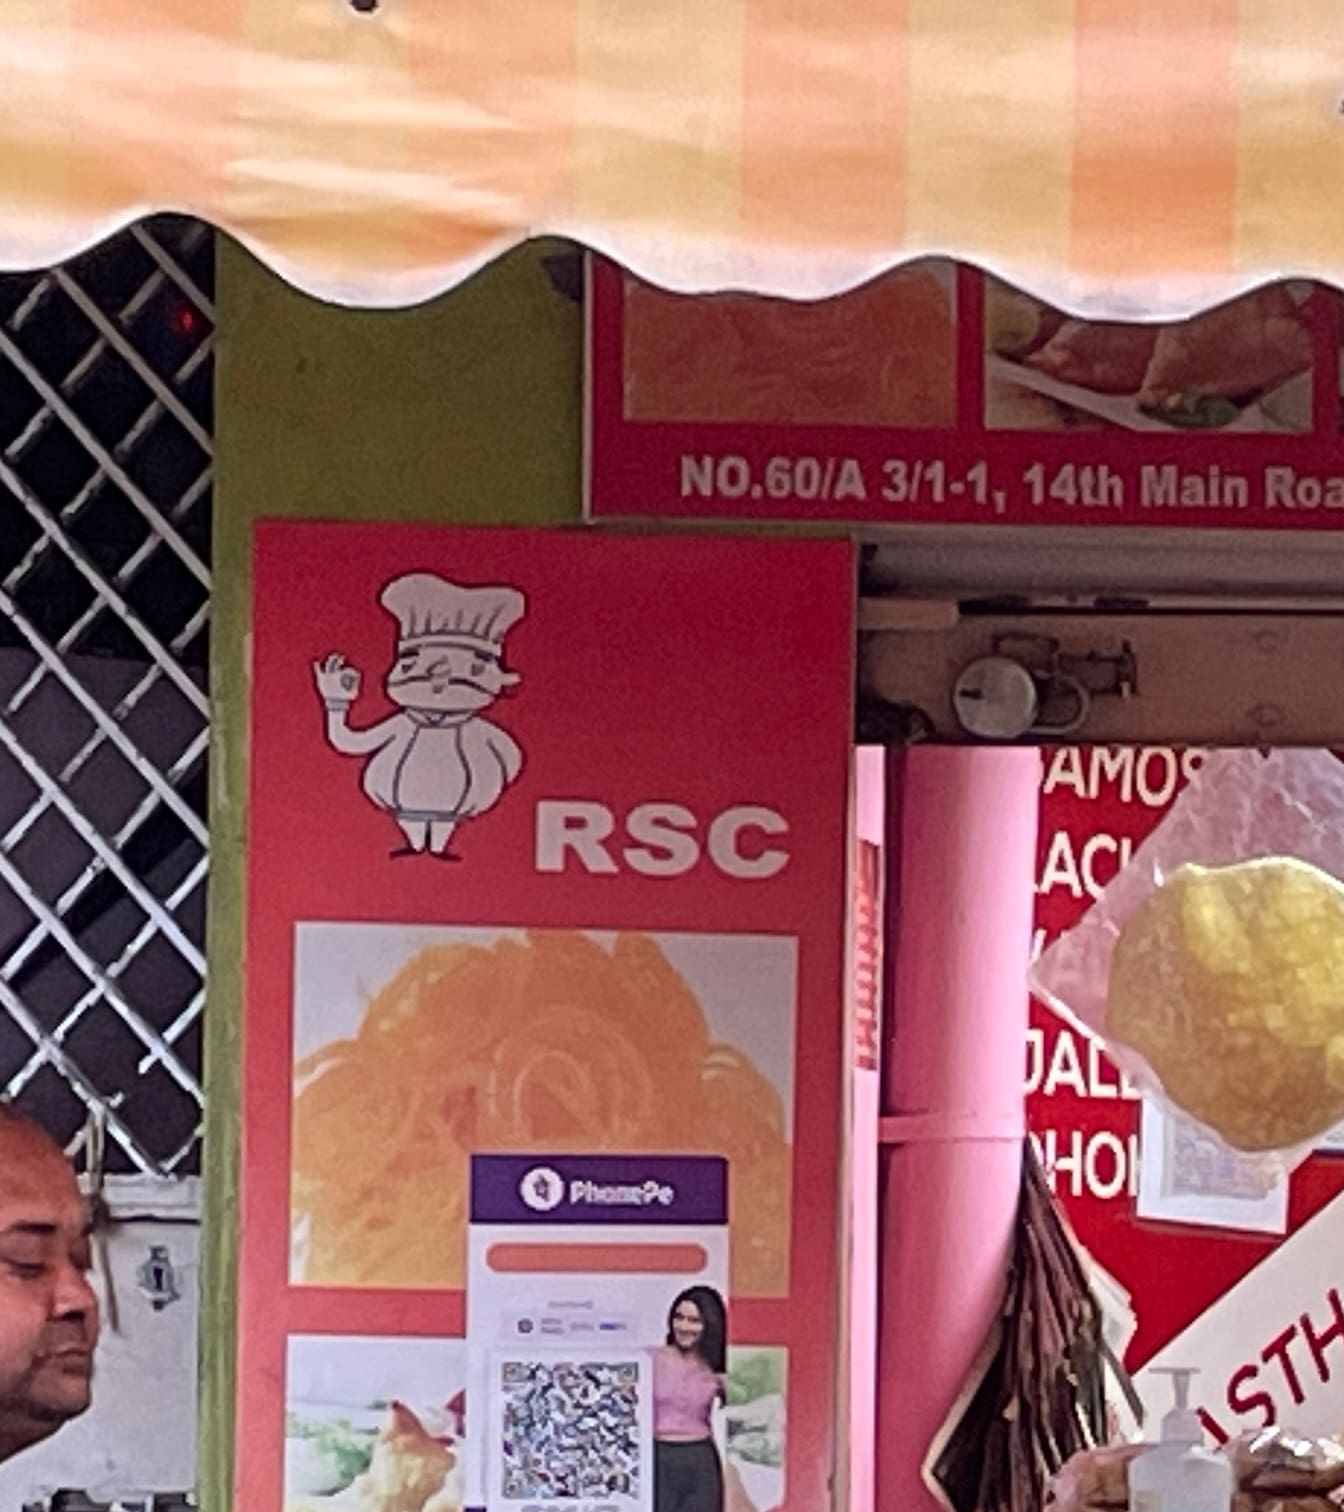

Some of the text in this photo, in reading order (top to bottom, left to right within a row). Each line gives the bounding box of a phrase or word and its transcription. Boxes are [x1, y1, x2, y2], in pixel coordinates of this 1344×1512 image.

[681, 456, 866, 498] NO.60/A
[882, 460, 1005, 513] 3/1-1,
[1024, 463, 1123, 505] 14th
[1141, 465, 1247, 507] Main
[535, 800, 790, 879] RSC
